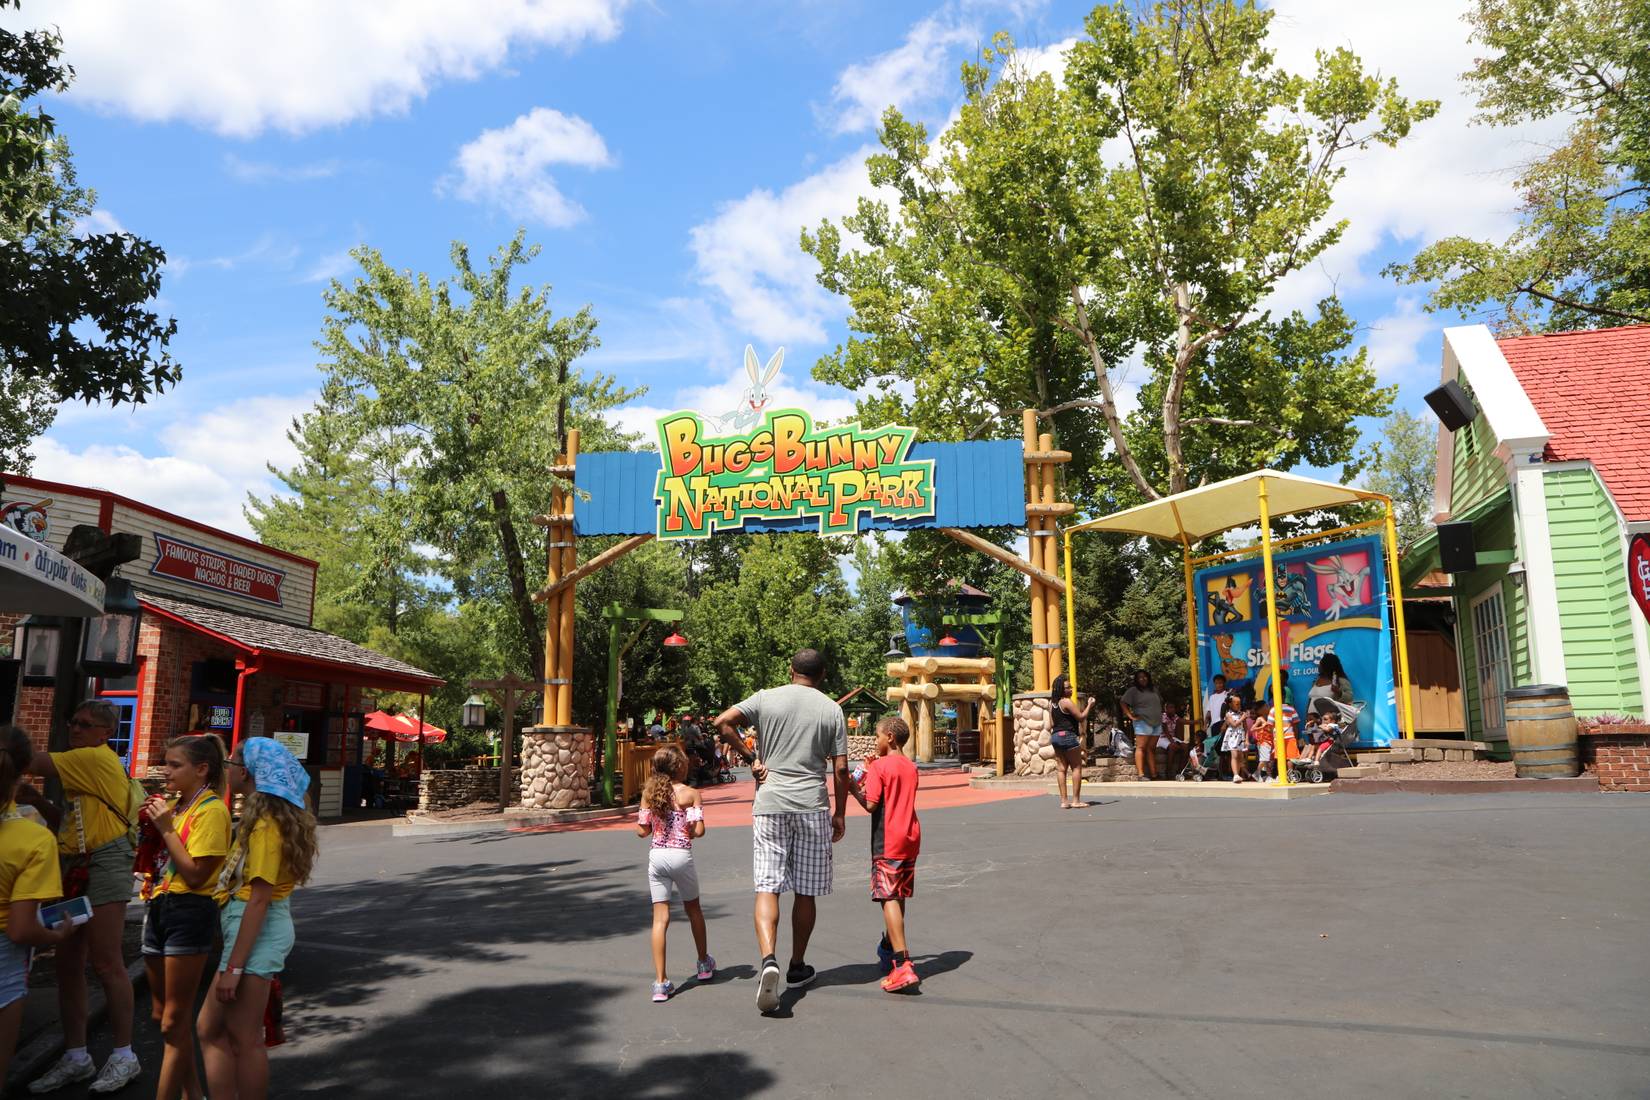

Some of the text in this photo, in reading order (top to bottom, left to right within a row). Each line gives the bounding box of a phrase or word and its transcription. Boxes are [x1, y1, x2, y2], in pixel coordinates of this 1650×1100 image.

[772, 414, 905, 474] BUNNY
[663, 469, 926, 532] NATIONAL PARK
[165, 543, 199, 565] FAMOUS
[199, 553, 228, 575] STRIPS,
[229, 562, 257, 581] LOADED
[194, 567, 251, 593] NACHOS & BEER
[1247, 648, 1271, 667] Six
